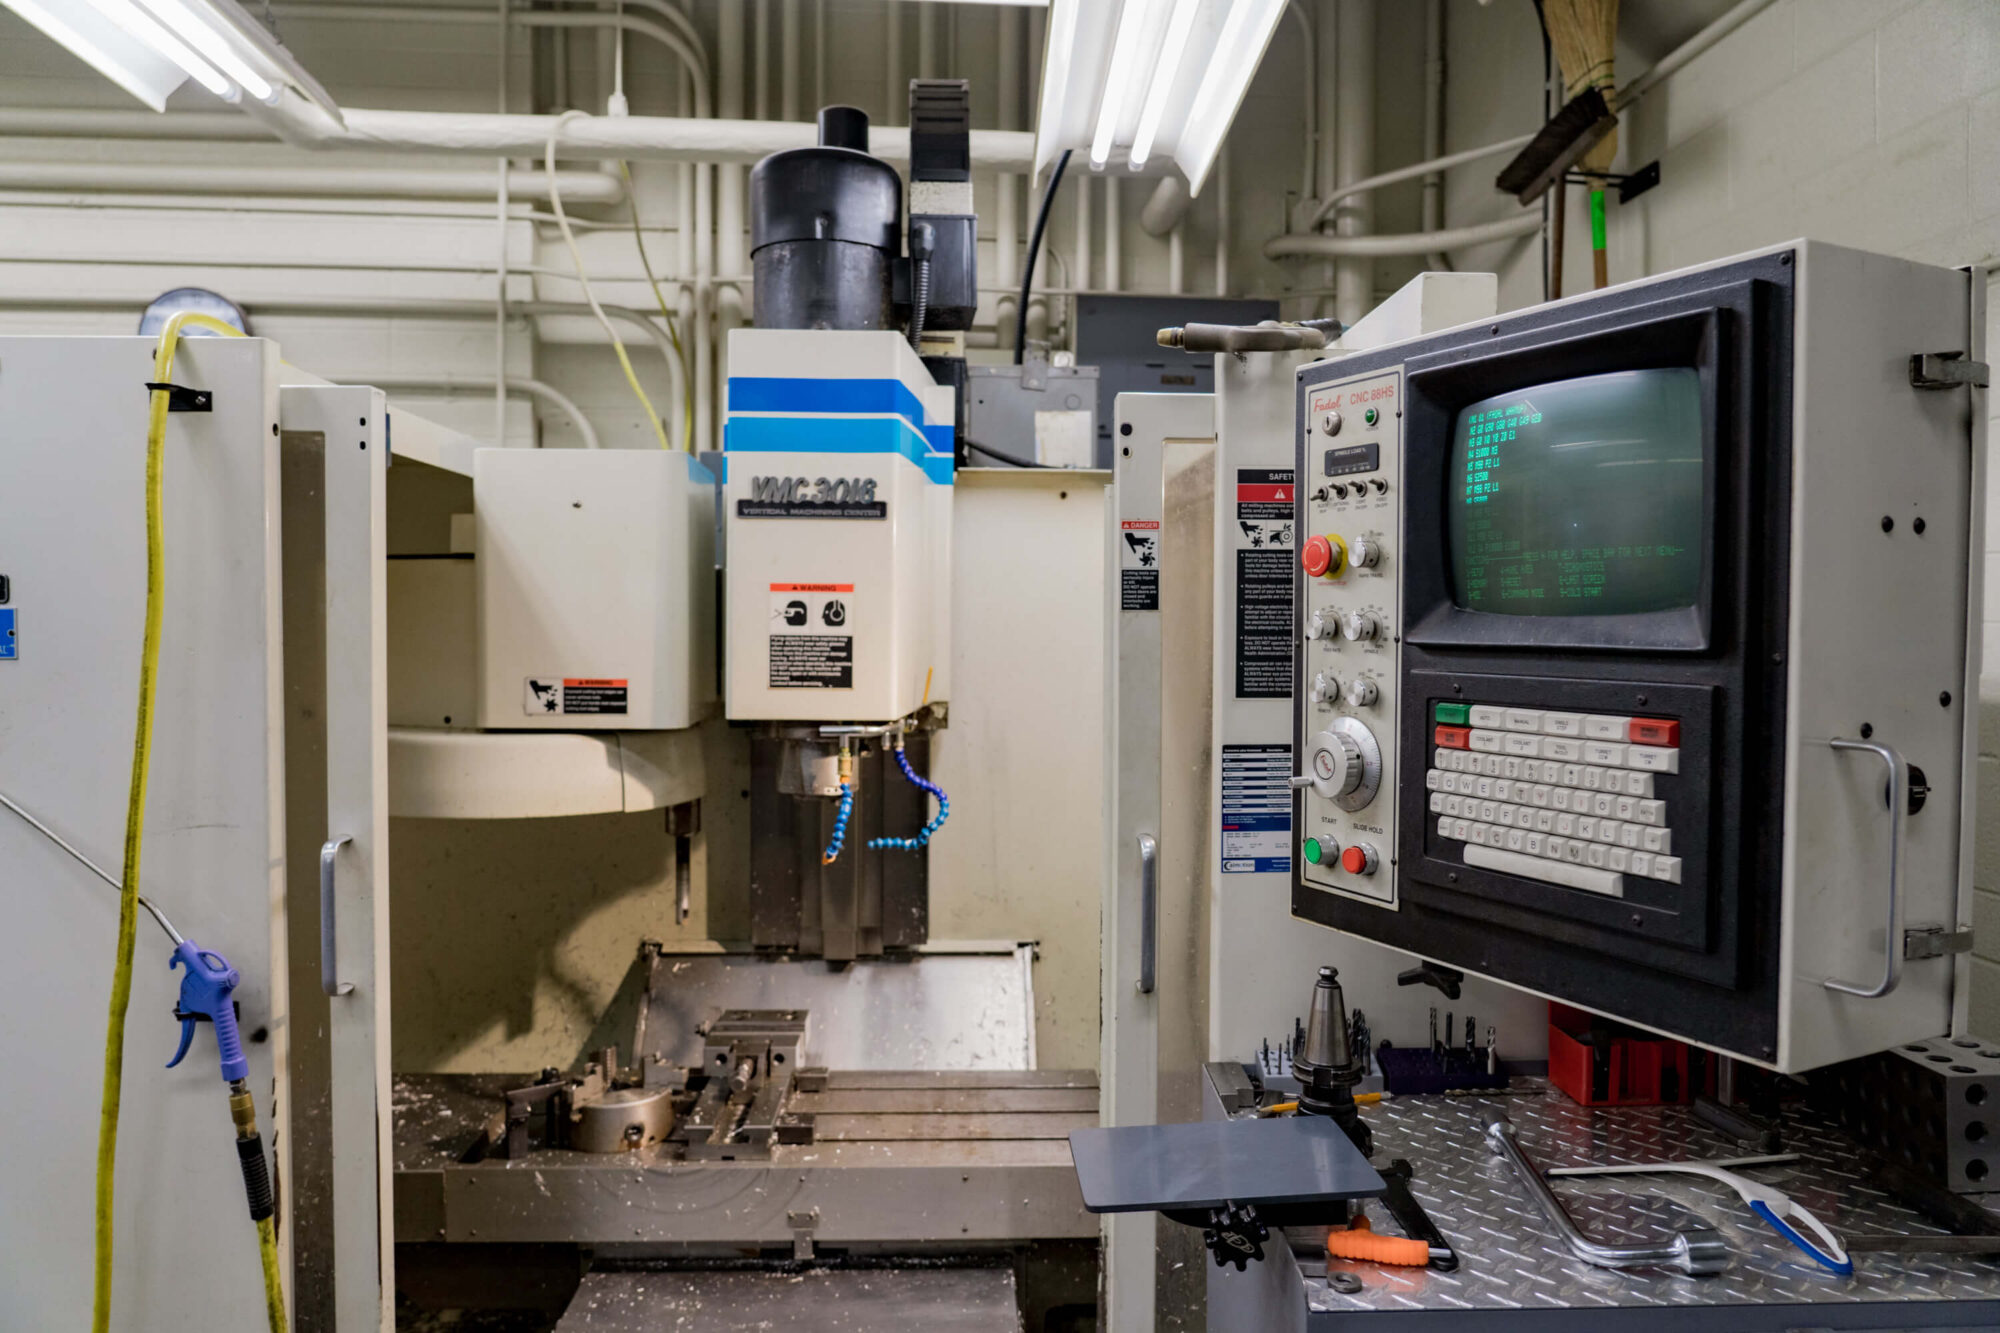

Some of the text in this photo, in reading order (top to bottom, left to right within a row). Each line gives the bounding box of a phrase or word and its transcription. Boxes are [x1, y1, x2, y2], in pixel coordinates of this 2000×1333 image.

[1314, 386, 1394, 412] Fadal CNC 88HS
[753, 476, 877, 504] VMC 3016
[1462, 781, 1470, 789] W
[1481, 784, 1486, 792] E
[1558, 796, 1563, 804] U
[1468, 806, 1472, 814] S
[1599, 802, 1606, 811] O
[1621, 805, 1628, 814] P
[1485, 809, 1491, 817] D
[1322, 816, 1337, 824] START
[1522, 815, 1528, 823] G
[1353, 823, 1383, 834] SLIDE HOLD
[1458, 827, 1464, 835] Z
[1583, 824, 1588, 833] K
[1494, 833, 1499, 843] C
[1604, 829, 1610, 838] L
[1512, 836, 1518, 845] V
[1531, 840, 1536, 849] B
[1551, 845, 1558, 854] N
[1570, 847, 1579, 858] M
